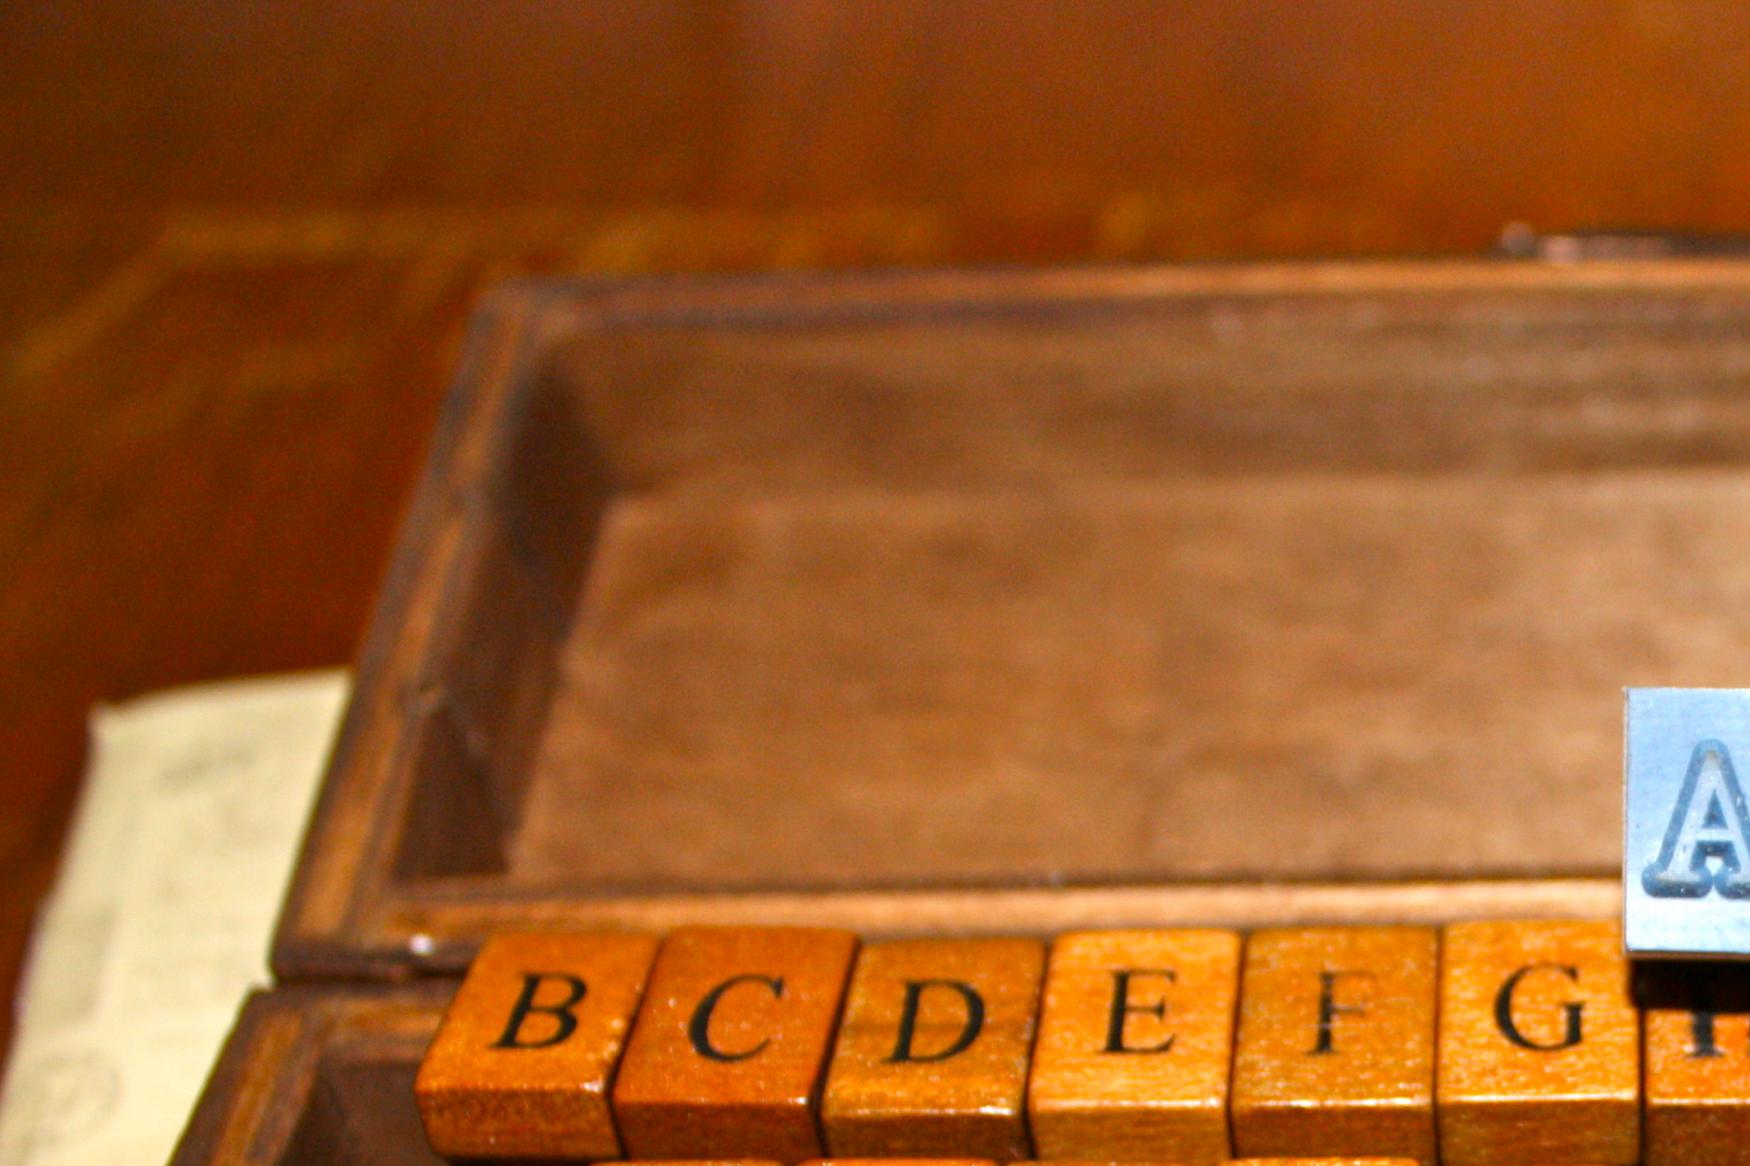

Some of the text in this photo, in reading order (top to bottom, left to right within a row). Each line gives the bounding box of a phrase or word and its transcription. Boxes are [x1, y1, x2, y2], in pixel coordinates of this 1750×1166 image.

[493, 973, 588, 1049] B
[688, 975, 784, 1063] C
[887, 981, 986, 1064] D
[1097, 967, 1177, 1055] E
[1304, 969, 1377, 1057] F
[1494, 967, 1584, 1051] G
